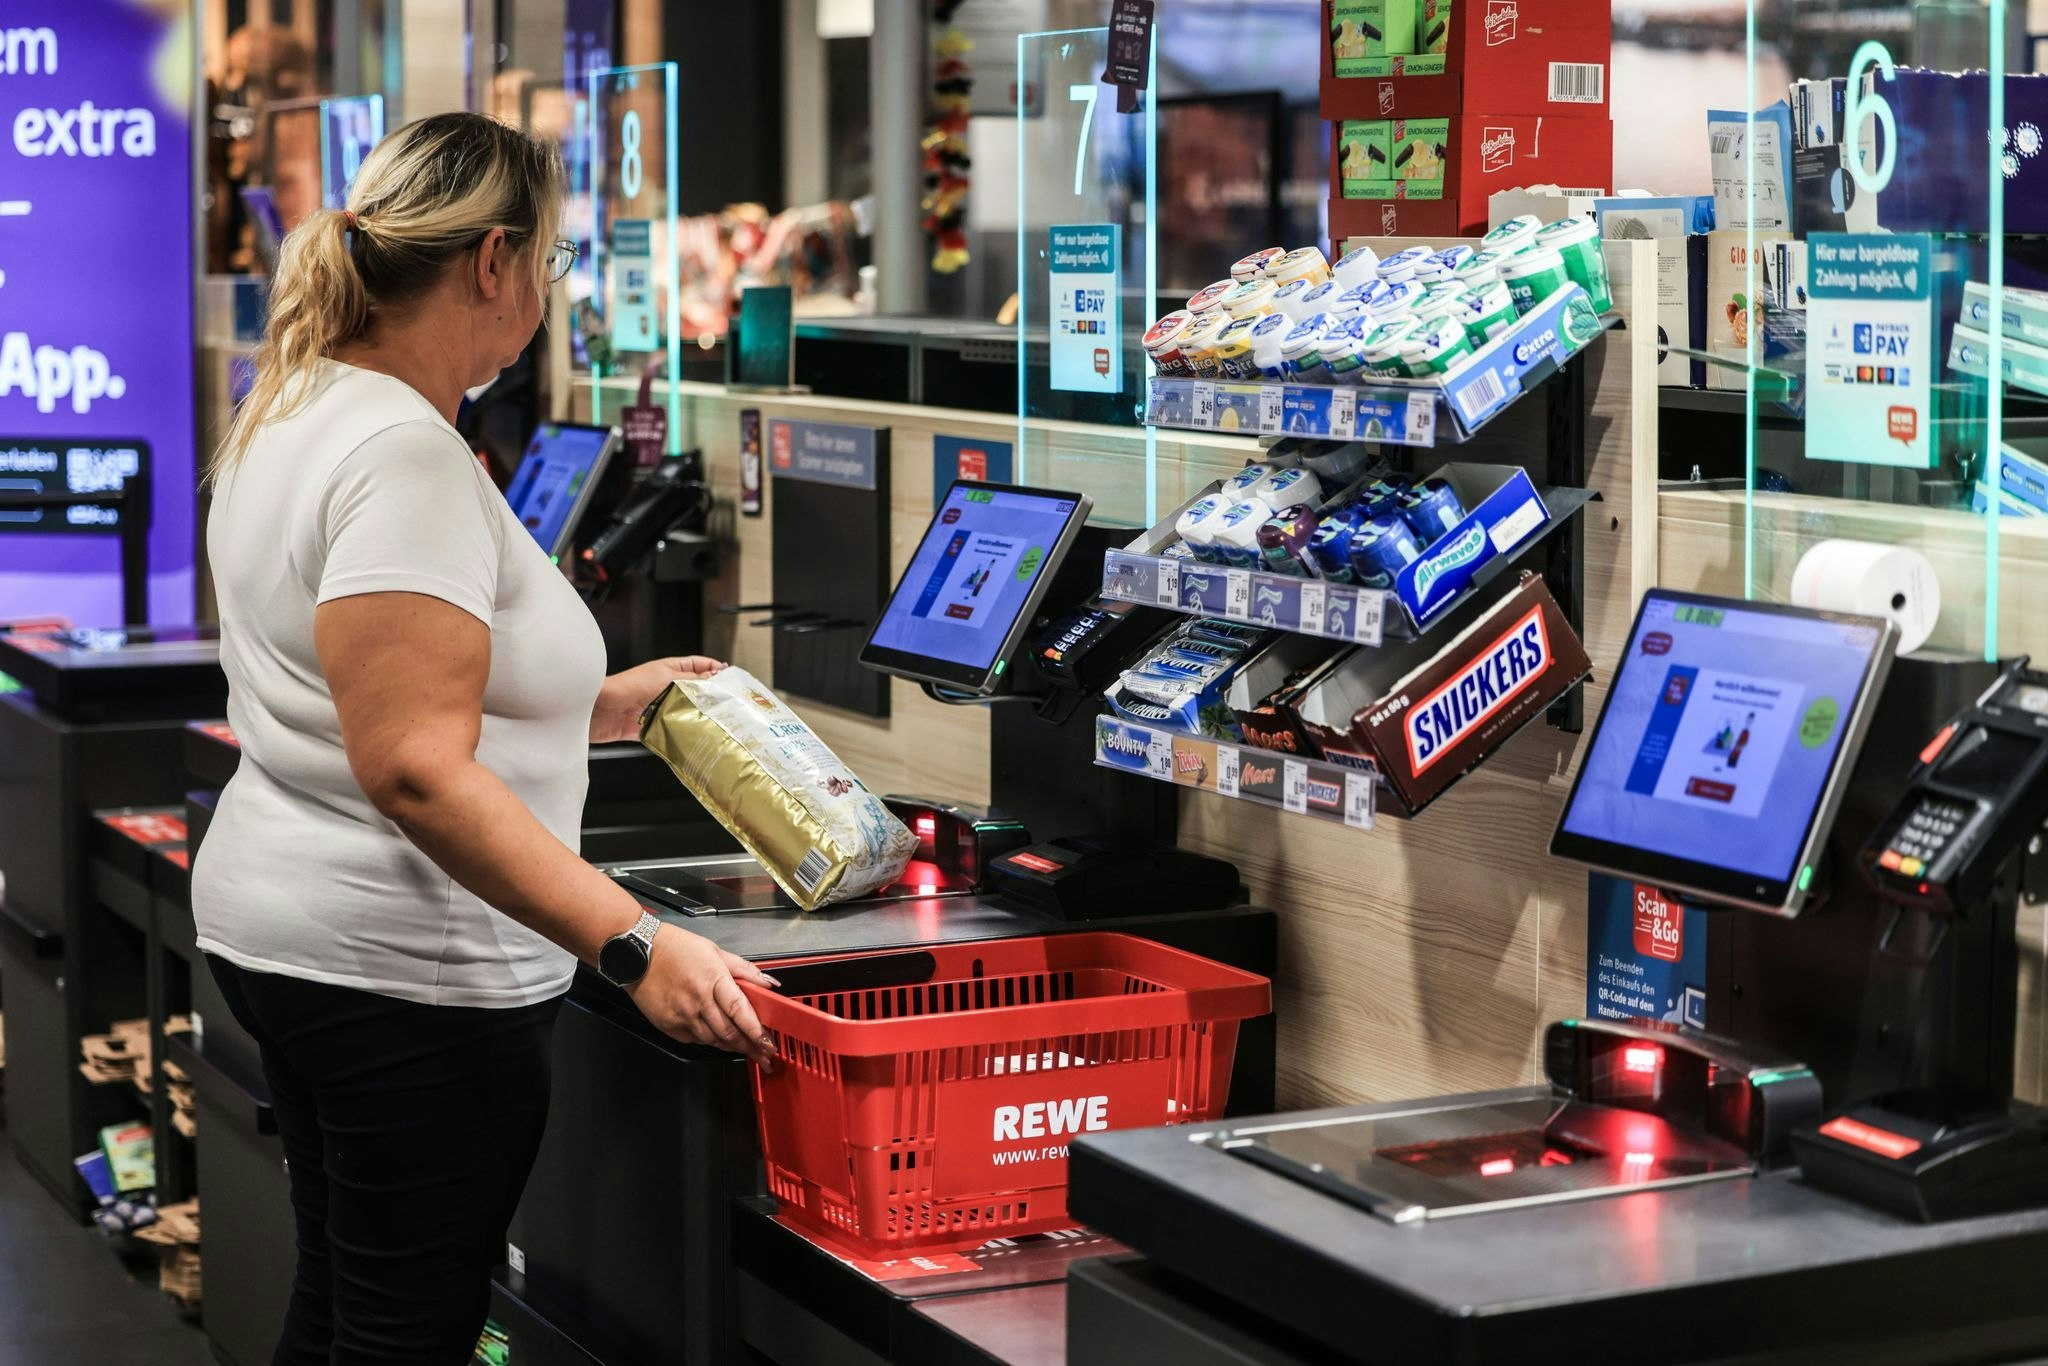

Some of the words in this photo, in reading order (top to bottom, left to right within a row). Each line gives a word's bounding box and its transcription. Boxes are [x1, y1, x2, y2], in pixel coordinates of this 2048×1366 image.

[13, 100, 156, 158] extra
[1846, 39, 1897, 194] 6
[1069, 85, 1098, 196] 7
[620, 109, 643, 200] 8
[1816, 243, 1837, 261] Hier
[1839, 247, 1857, 261] nur
[1858, 243, 1919, 267] bargeldlose
[1816, 268, 1857, 293] Zahlung
[1858, 269, 1903, 293] möglich.
[1087, 298, 1105, 314] PAY
[1515, 328, 1555, 362] extra
[1876, 335, 1910, 356] PAY
[0, 332, 127, 414] App.
[1200, 400, 1213, 416] 3,45
[1268, 404, 1281, 421] 3,45
[1418, 531, 1482, 595] Airwaves
[1414, 621, 1542, 761] SNICKERS
[1107, 732, 1144, 757] BOUNTY
[1241, 722, 1297, 752] Mars
[1175, 751, 1203, 774] Twix
[1240, 762, 1276, 787] Mars
[1638, 891, 1667, 918] Scan
[1652, 918, 1680, 944] &Go
[1599, 954, 1614, 968] Zum
[1614, 958, 1644, 977] Beenden
[1598, 971, 1611, 984] des
[1612, 974, 1641, 993] Einkaufs
[1642, 981, 1655, 996] den
[1598, 986, 1627, 1006] QR-Code
[1628, 996, 1640, 1009] auf
[1640, 998, 1654, 1013] dem
[993, 1096, 1108, 1142] REWE
